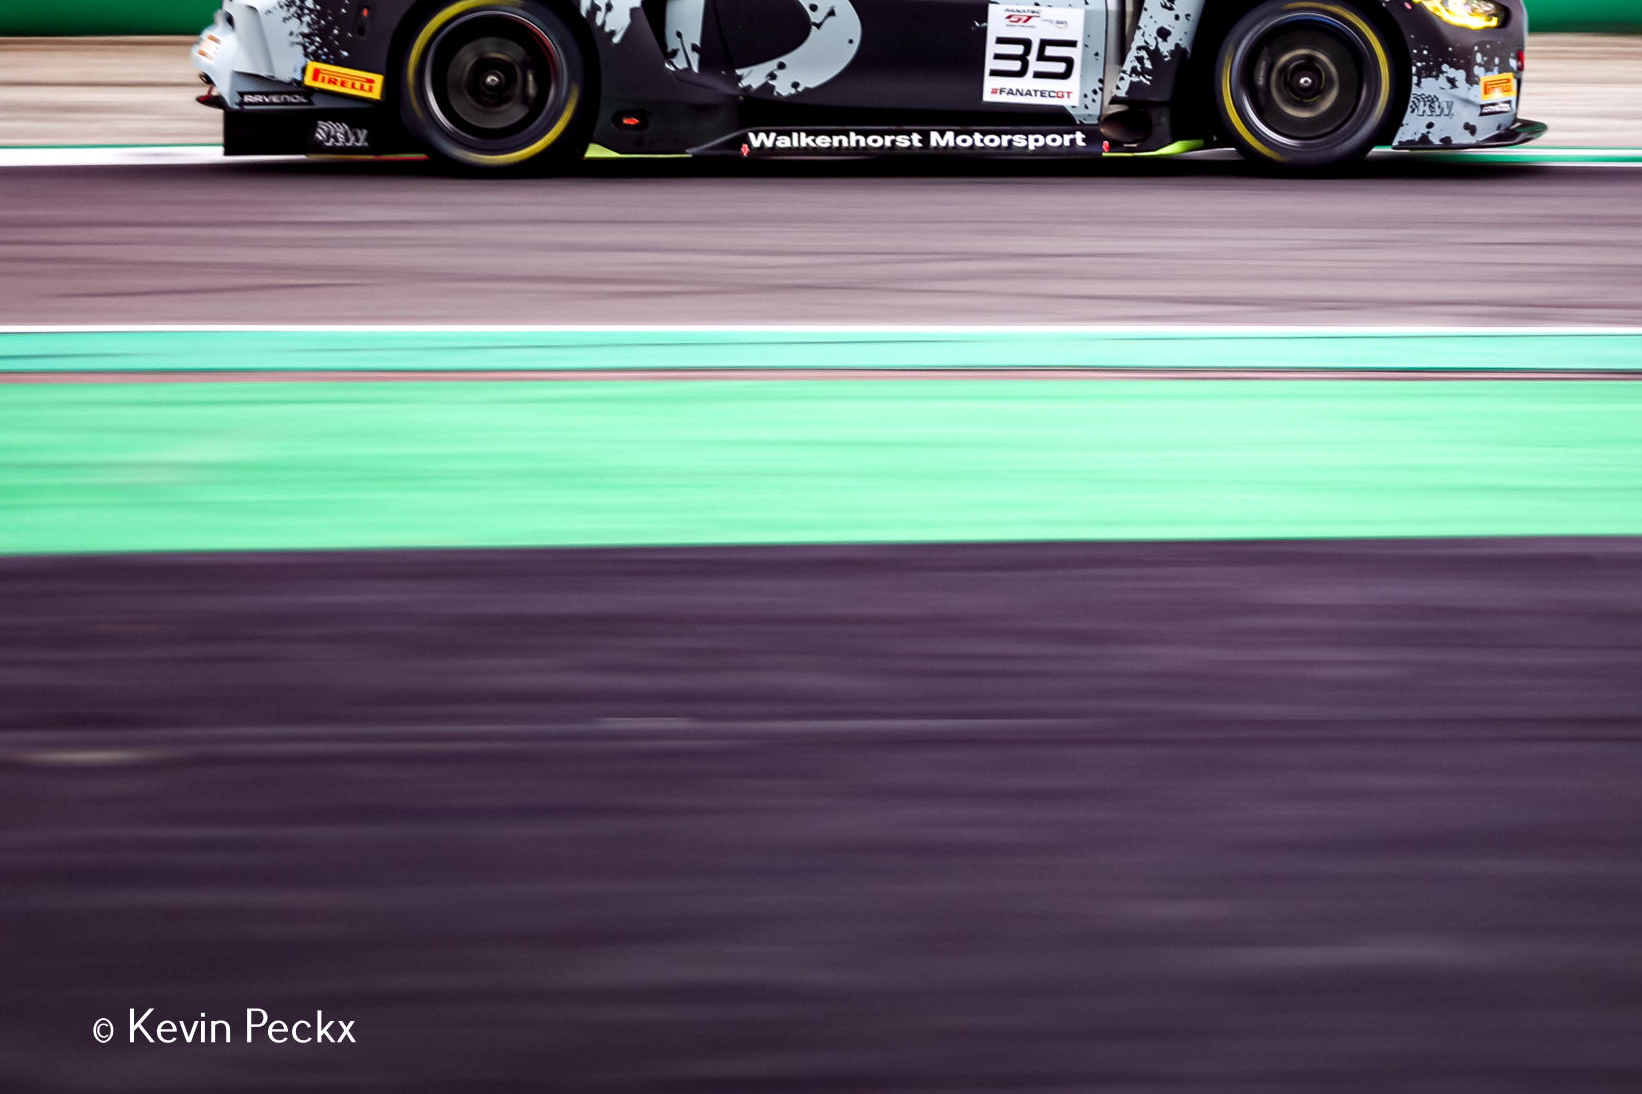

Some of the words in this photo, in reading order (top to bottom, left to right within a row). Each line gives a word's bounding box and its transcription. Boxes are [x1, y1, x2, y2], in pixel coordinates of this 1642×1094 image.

[989, 36, 1078, 81] 35
[311, 67, 375, 93] PIRELLI
[243, 93, 309, 104] RAVENOL
[991, 87, 1072, 99] #FANATECGT
[748, 131, 923, 147] Walkenhorst
[930, 131, 1086, 150] Motorsport
